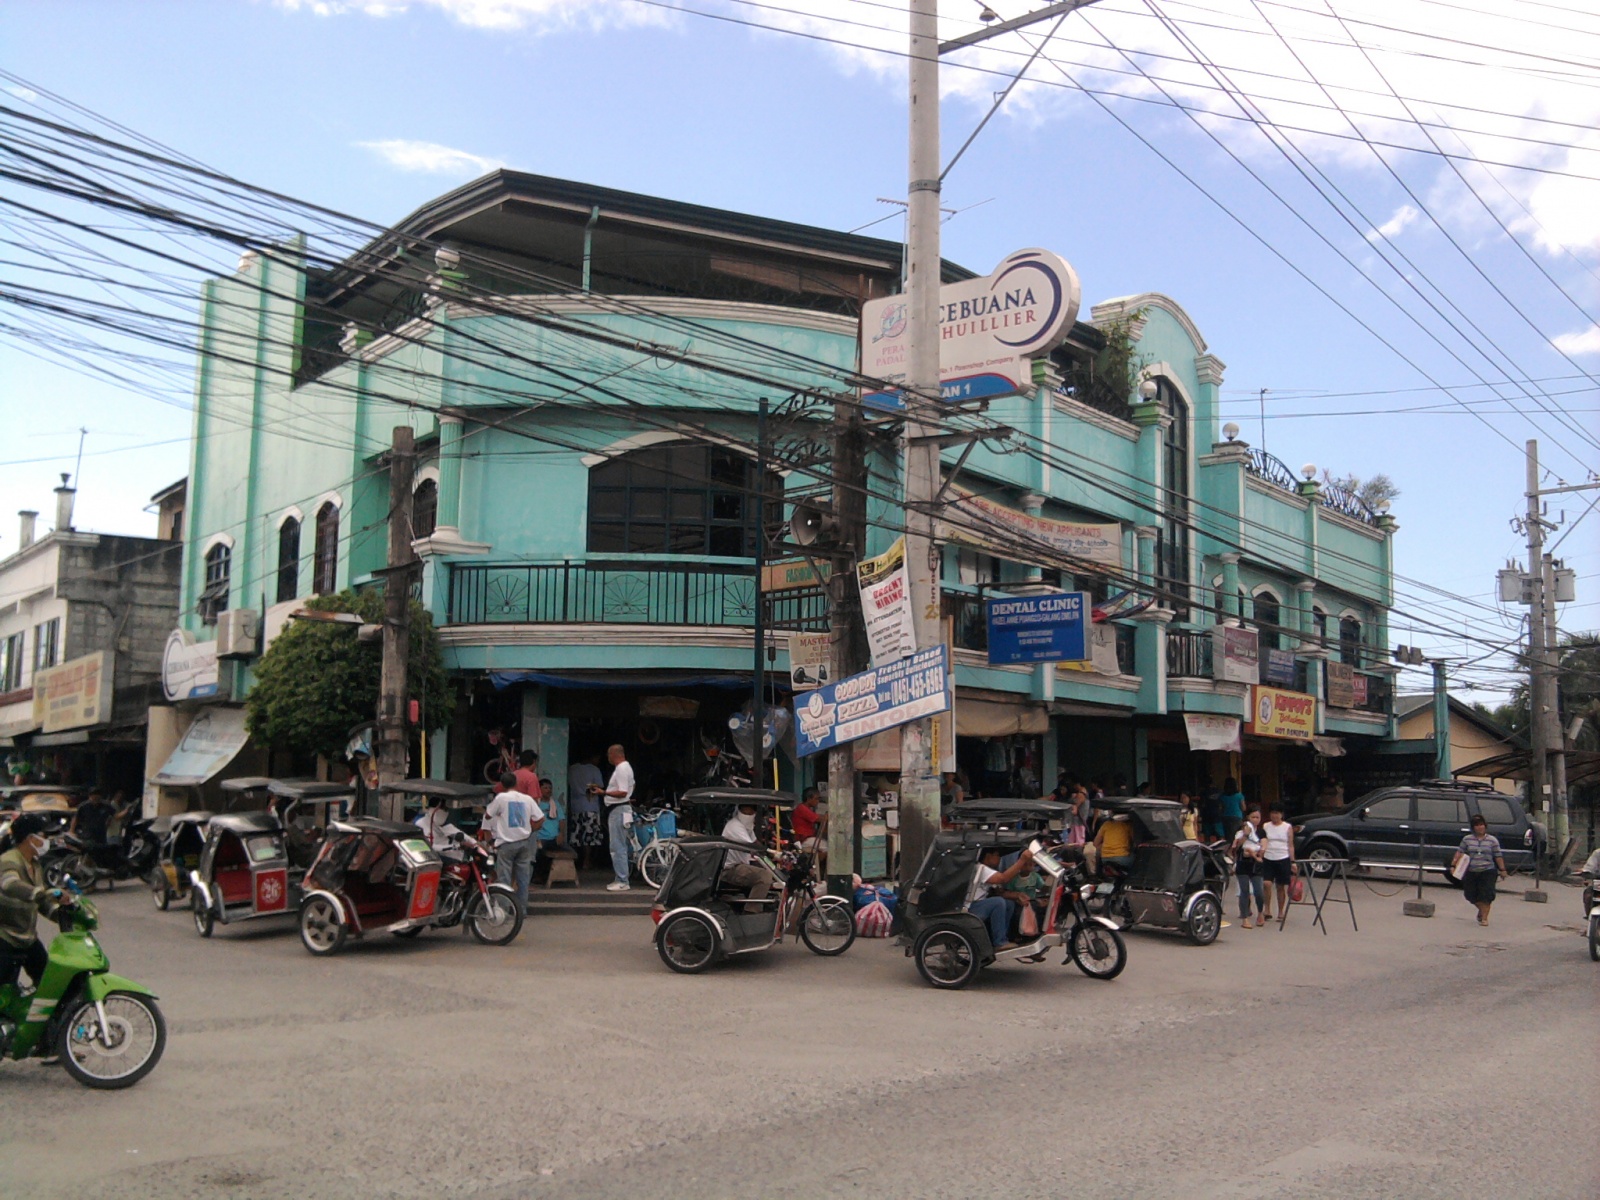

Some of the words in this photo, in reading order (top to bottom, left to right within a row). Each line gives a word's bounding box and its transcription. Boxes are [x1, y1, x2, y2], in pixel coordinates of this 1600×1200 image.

[942, 309, 1037, 340] HUILLIER
[876, 353, 907, 367] PADAL
[986, 356, 1014, 367] Company
[875, 588, 904, 609] HIRING
[992, 601, 1037, 616] DENTAL
[1039, 597, 1080, 612] CLINIC
[913, 646, 942, 665] Baked
[838, 696, 878, 722] PIZZA
[842, 696, 938, 738] SINTODA
